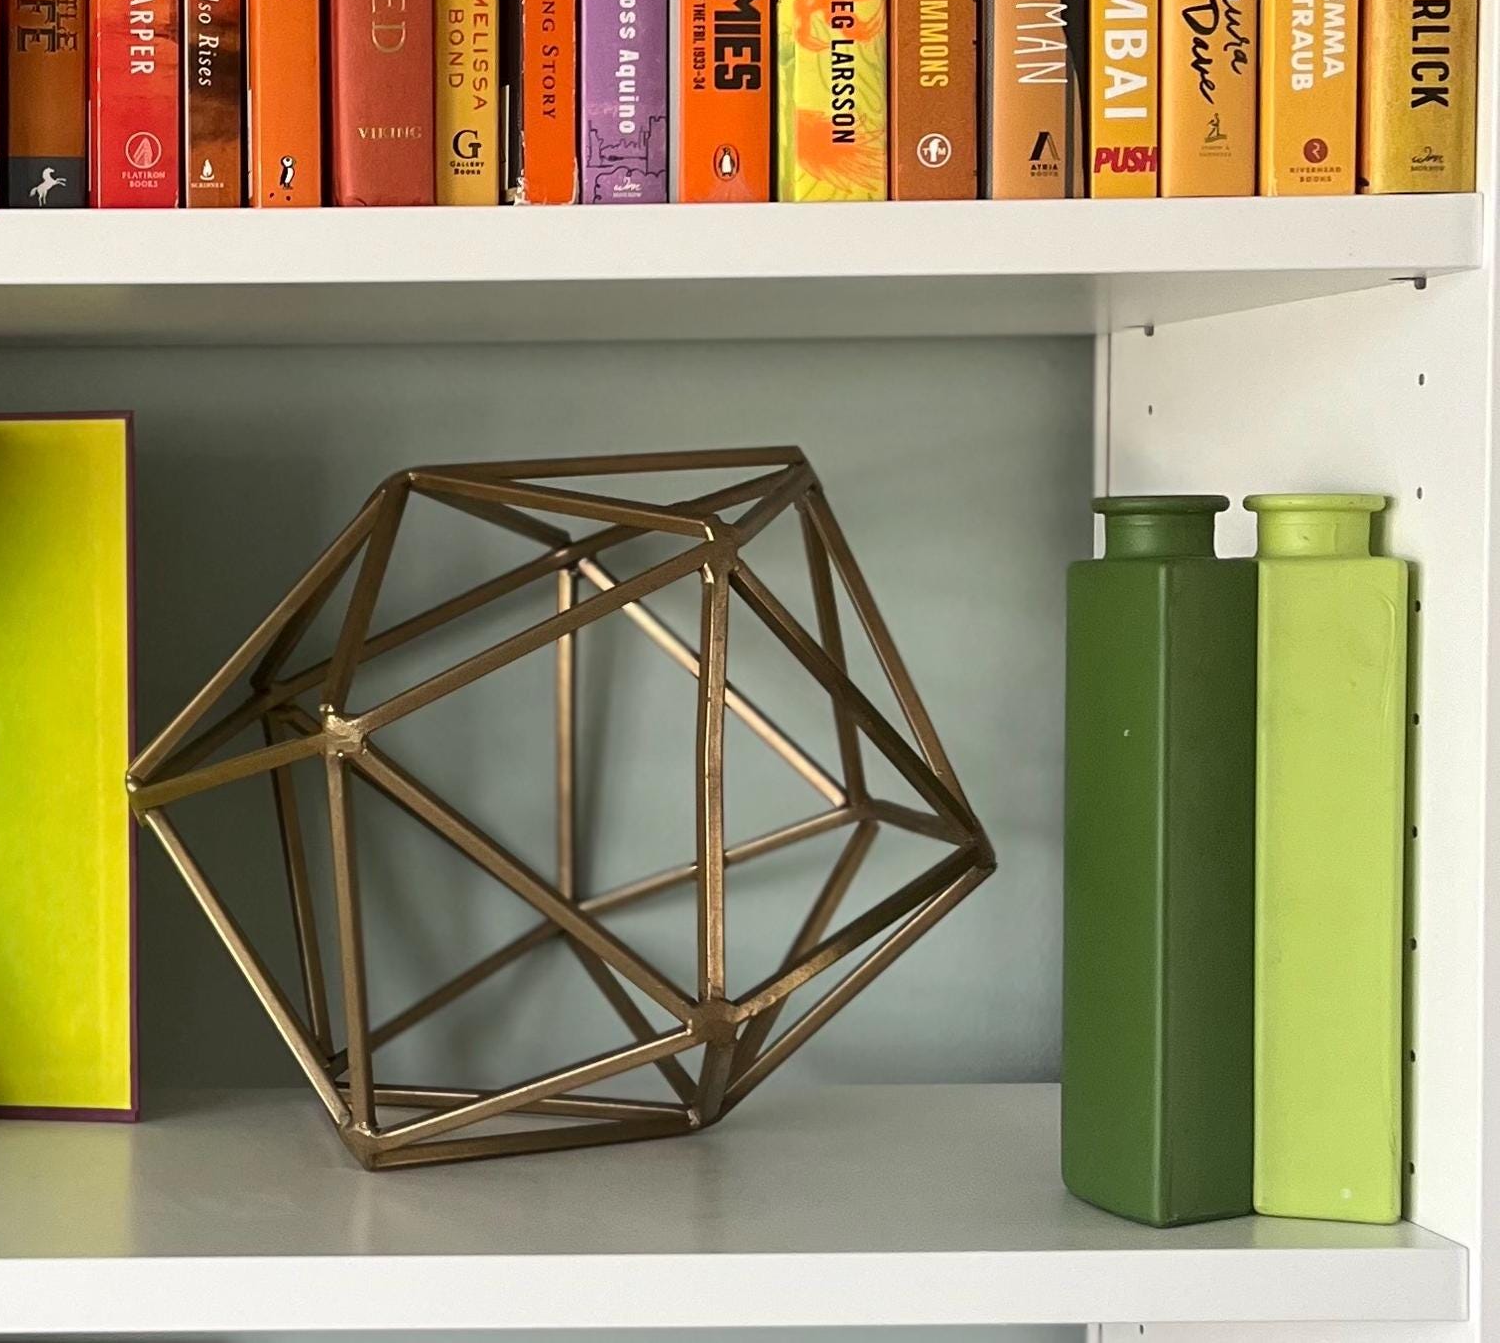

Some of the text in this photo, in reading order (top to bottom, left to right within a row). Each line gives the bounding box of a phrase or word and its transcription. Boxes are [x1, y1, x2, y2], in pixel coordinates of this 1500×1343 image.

[692, 3, 706, 22] THE
[615, 48, 641, 135] Aquino
[831, 39, 855, 144] LARSSON
[357, 125, 422, 141] VIKING
[1093, 146, 1158, 174] PUSH
